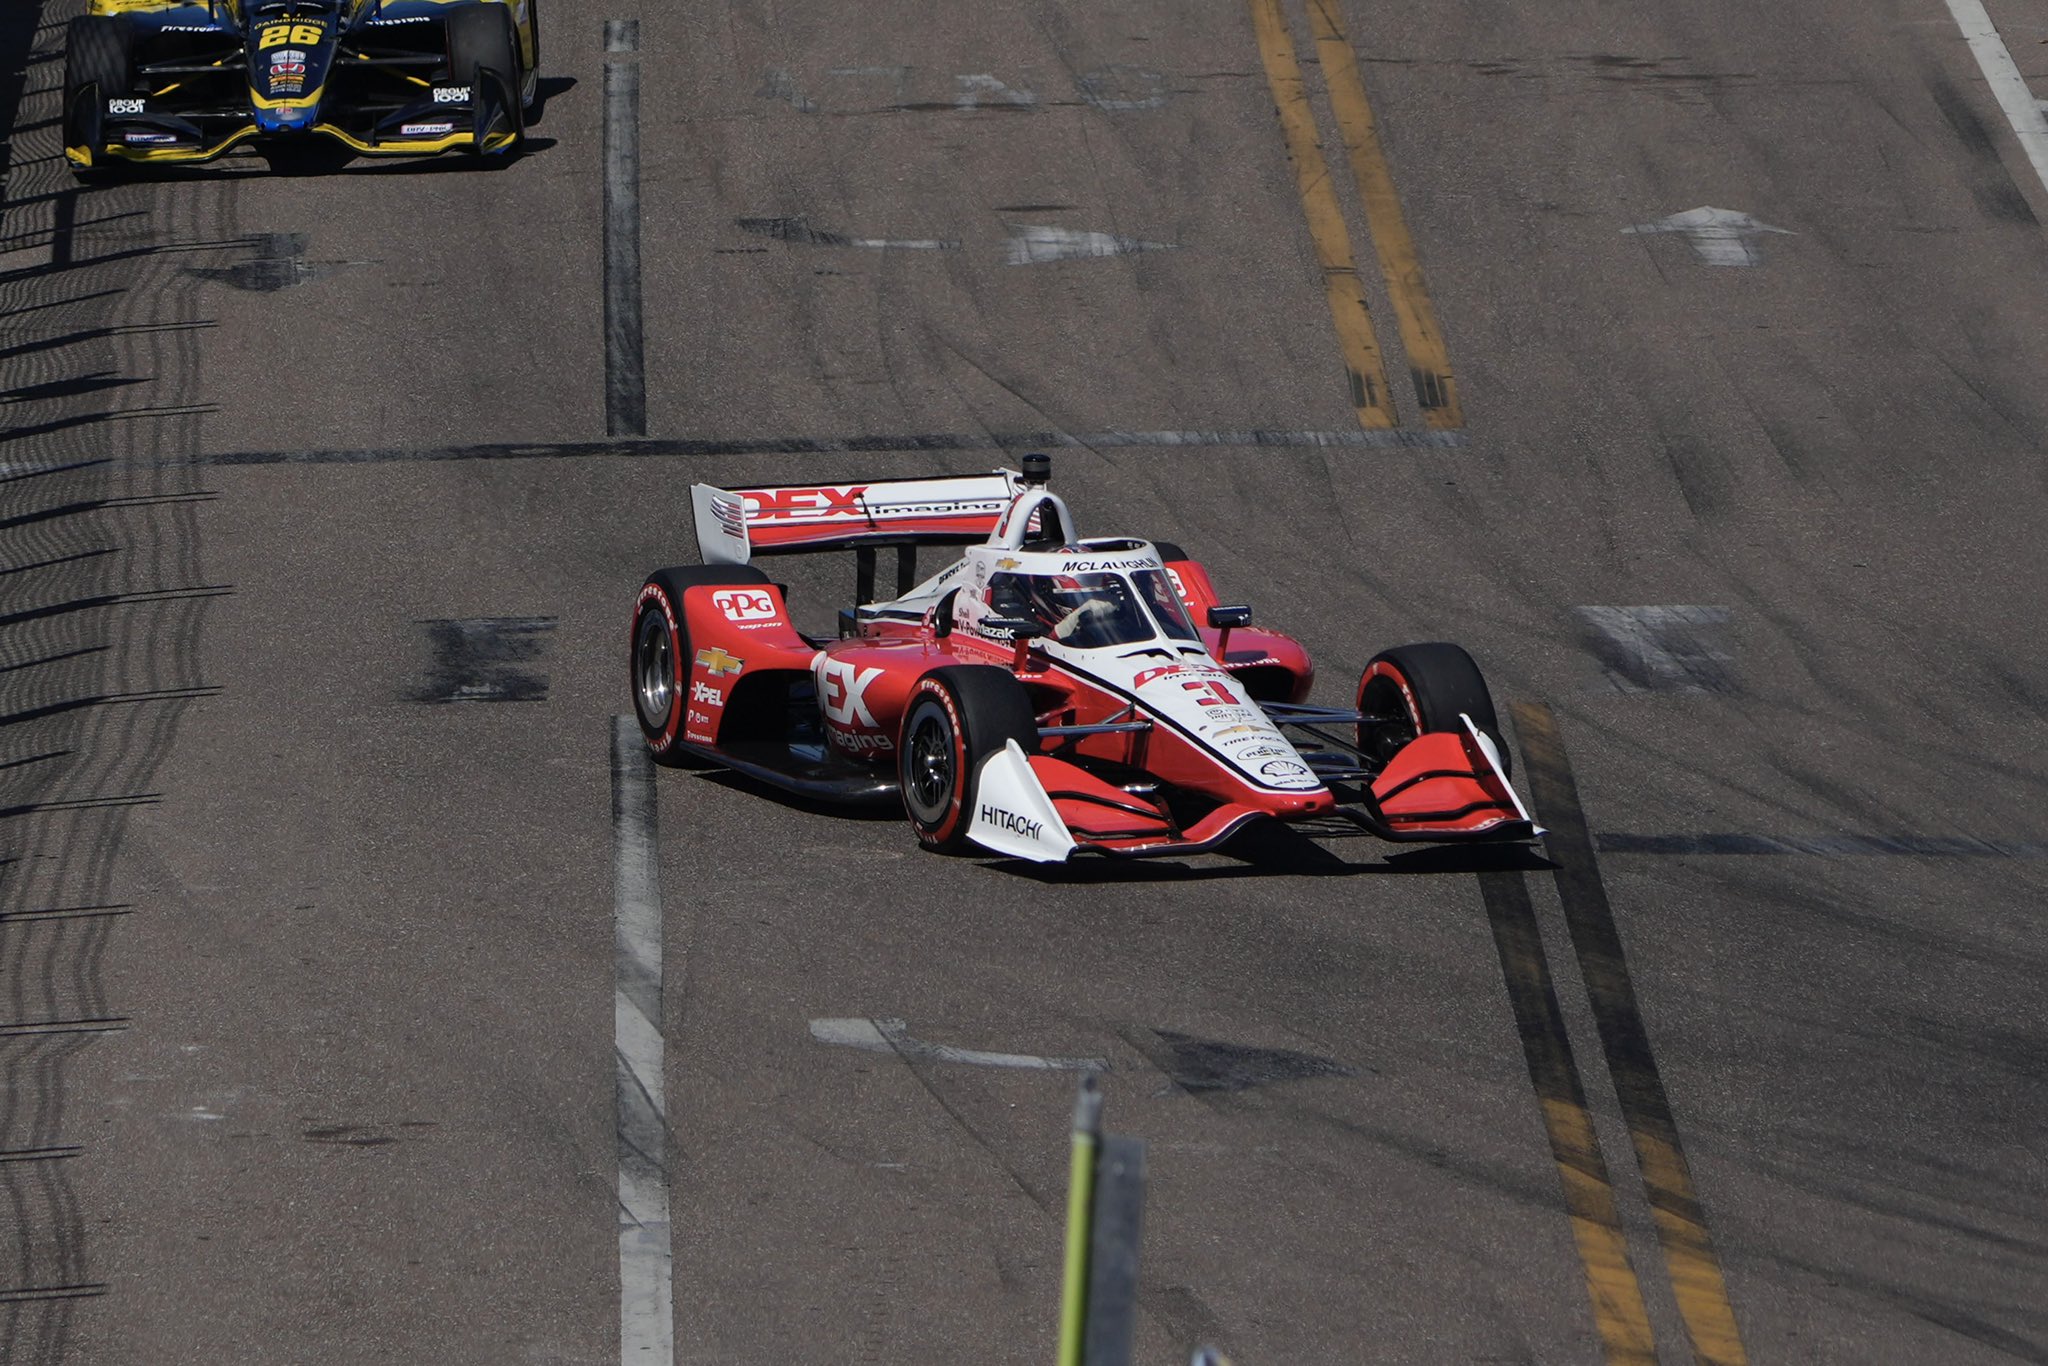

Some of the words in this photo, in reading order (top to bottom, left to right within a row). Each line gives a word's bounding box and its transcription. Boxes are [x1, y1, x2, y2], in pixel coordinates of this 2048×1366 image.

[258, 24, 323, 51] 26
[108, 98, 146, 107] GROUP
[432, 93, 469, 103] 1001
[108, 104, 144, 114] 1001
[874, 501, 1001, 516] imaging
[716, 592, 774, 618] PPG
[978, 623, 1016, 640] Mazak
[691, 680, 724, 707] XPEL
[826, 723, 896, 753] aging
[981, 803, 1044, 841] HITACHI
